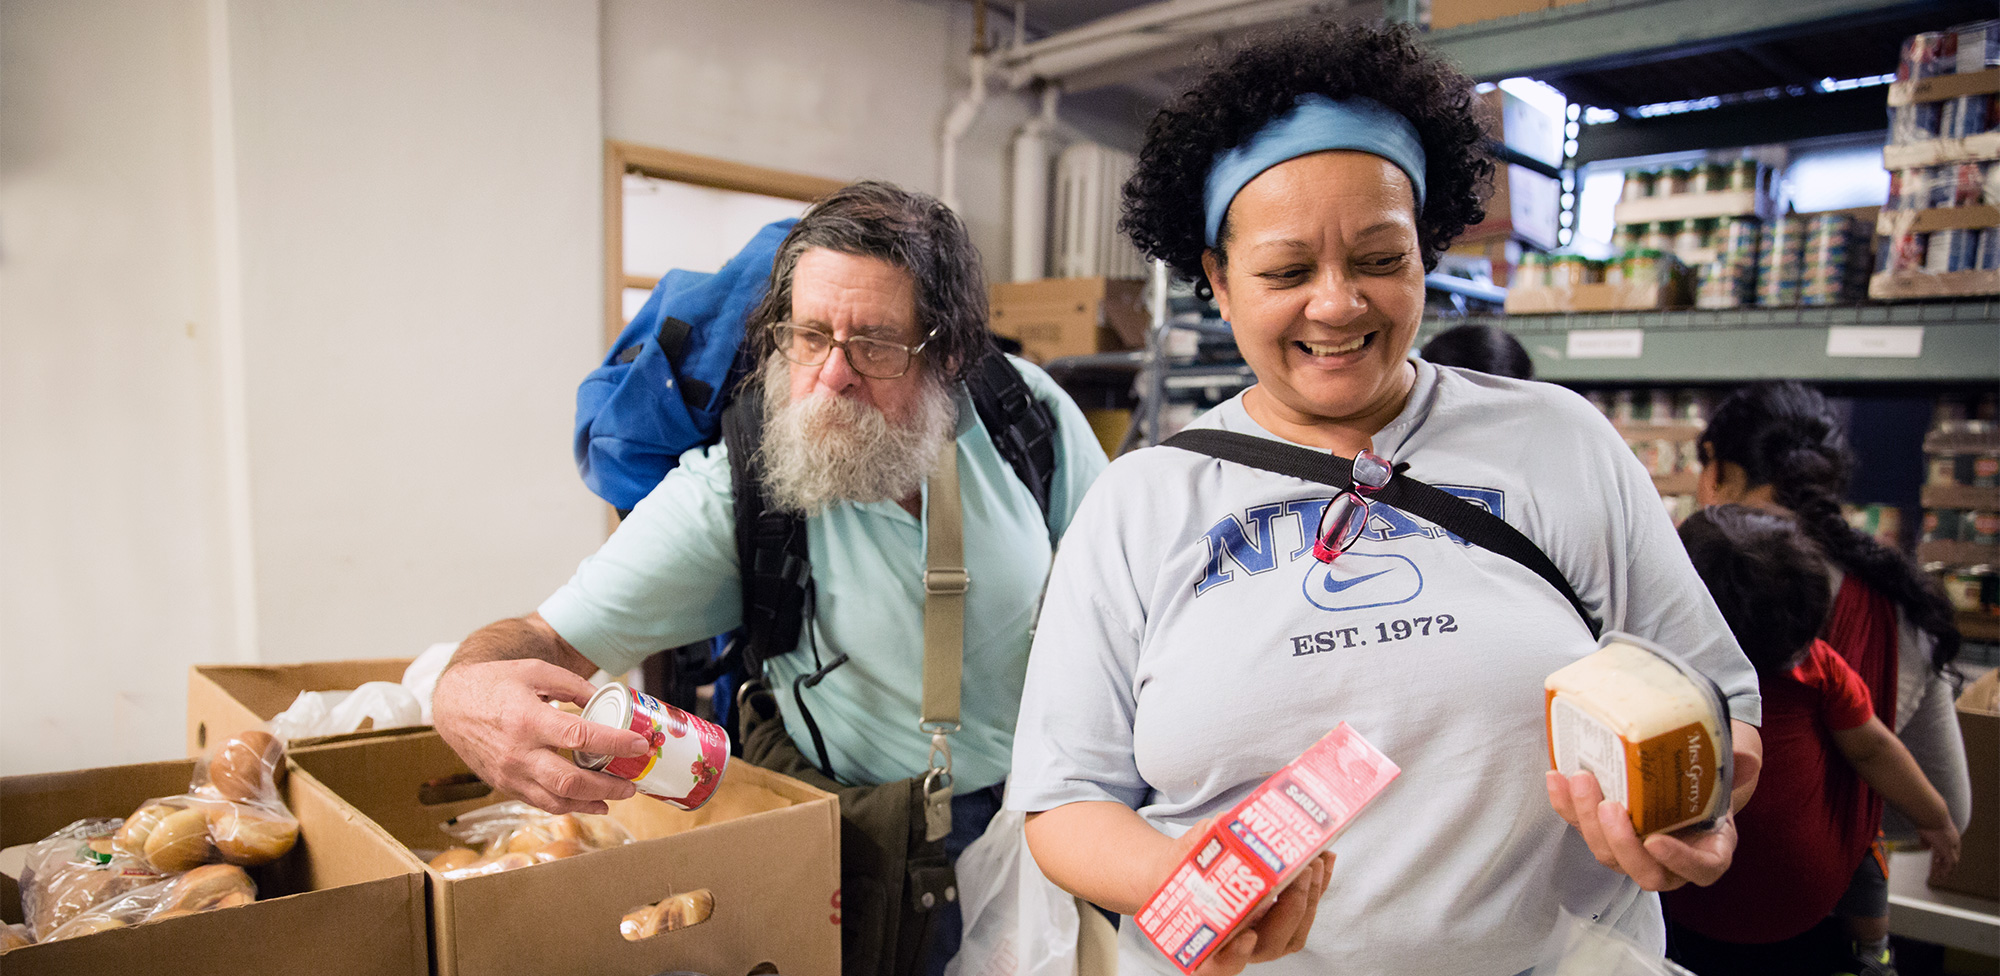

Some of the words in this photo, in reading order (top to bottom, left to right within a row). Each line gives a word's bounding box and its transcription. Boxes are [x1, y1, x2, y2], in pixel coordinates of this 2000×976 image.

[1290, 626, 1366, 656] EST.
[1375, 614, 1458, 644] 1972
[1284, 782, 1328, 824] STRIPS
[1237, 803, 1301, 867] SEITAN
[1297, 823, 1321, 846] 21
[1178, 903, 1202, 929] 21
[1199, 861, 1267, 932] SEITAN
